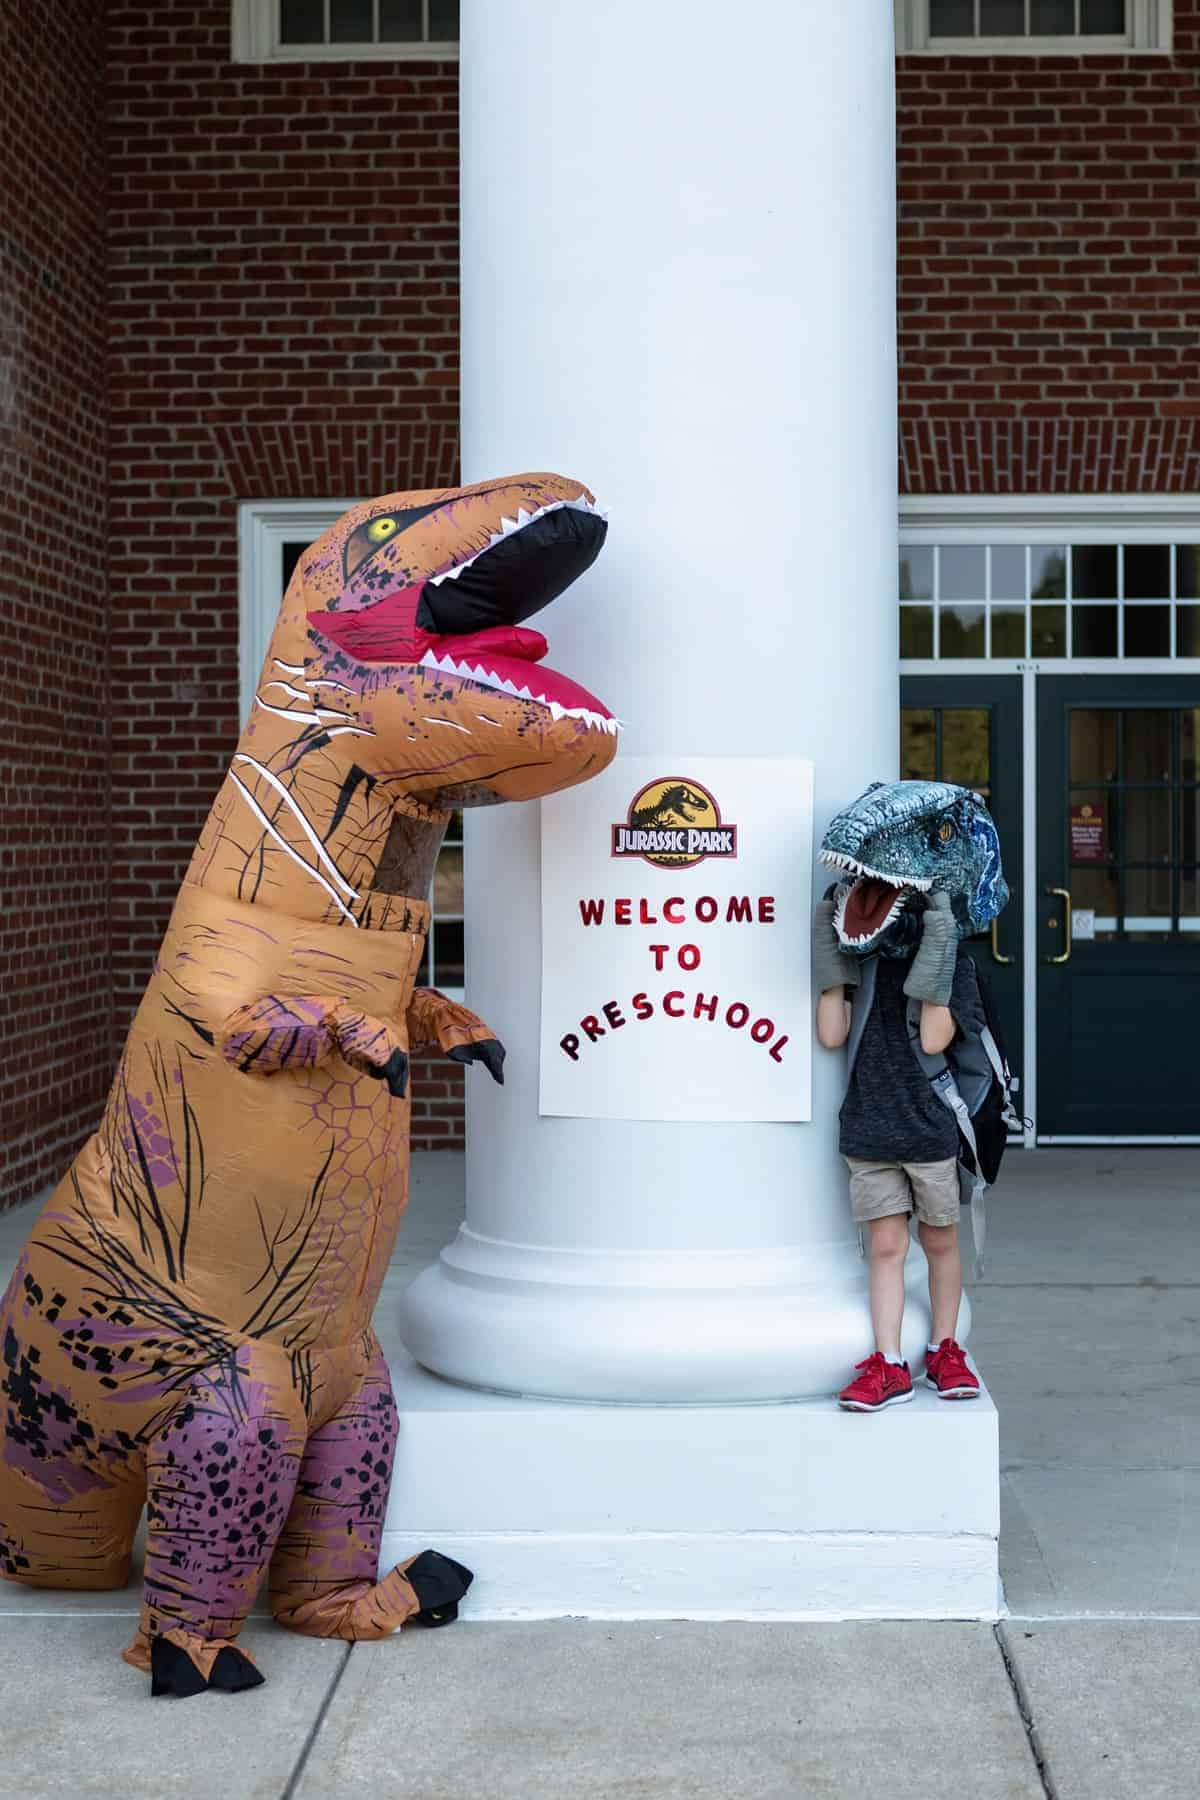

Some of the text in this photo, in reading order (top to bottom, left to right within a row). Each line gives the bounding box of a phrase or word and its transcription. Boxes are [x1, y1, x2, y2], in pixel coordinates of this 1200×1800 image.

[616, 828, 732, 853] JURASSIC PARK
[579, 896, 775, 926] WELCOME
[649, 944, 701, 972] TO
[560, 990, 789, 1063] PRESCHOOL
